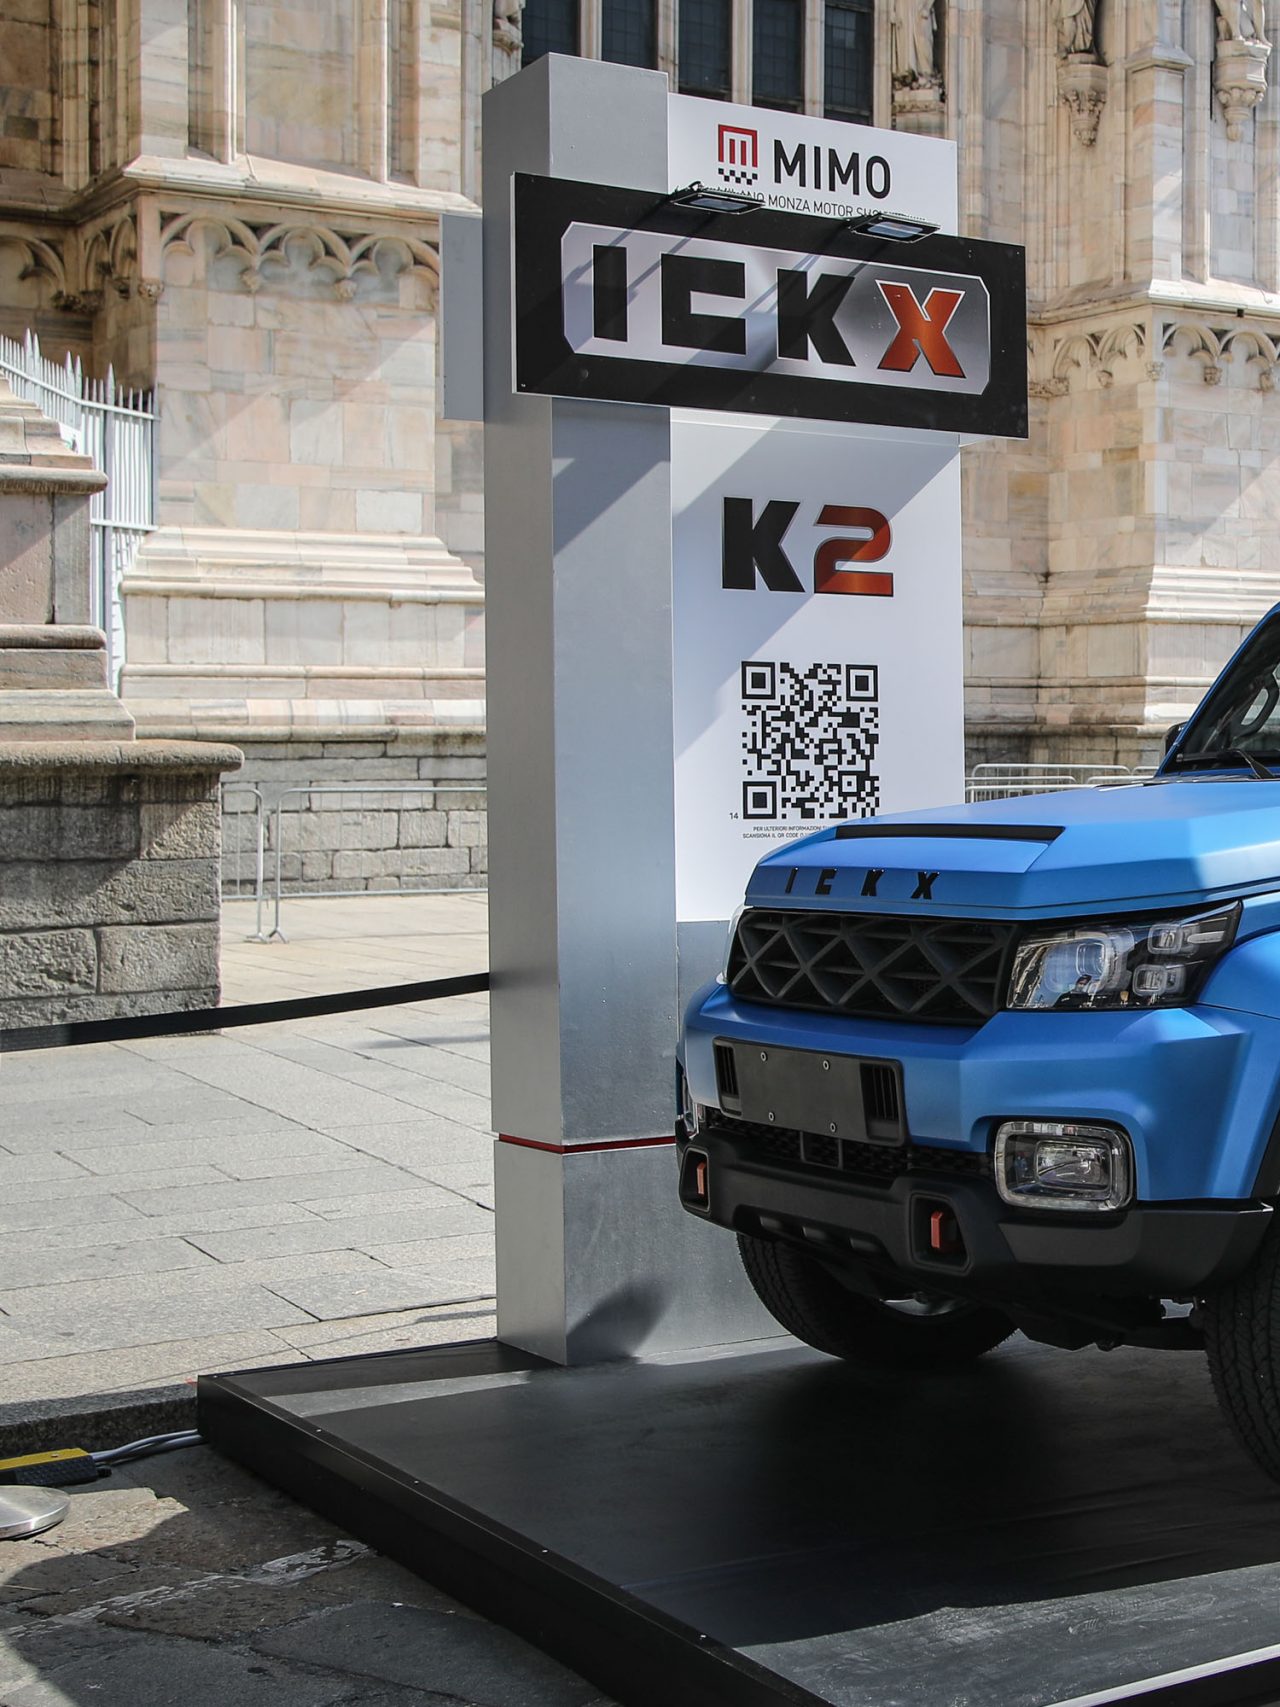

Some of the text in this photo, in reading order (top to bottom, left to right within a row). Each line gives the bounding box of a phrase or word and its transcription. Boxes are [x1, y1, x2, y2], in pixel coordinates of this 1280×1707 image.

[774, 139, 890, 199] MIMO
[768, 194, 811, 213] MONZA
[813, 200, 853, 217] MOTOR
[722, 497, 893, 597] K2
